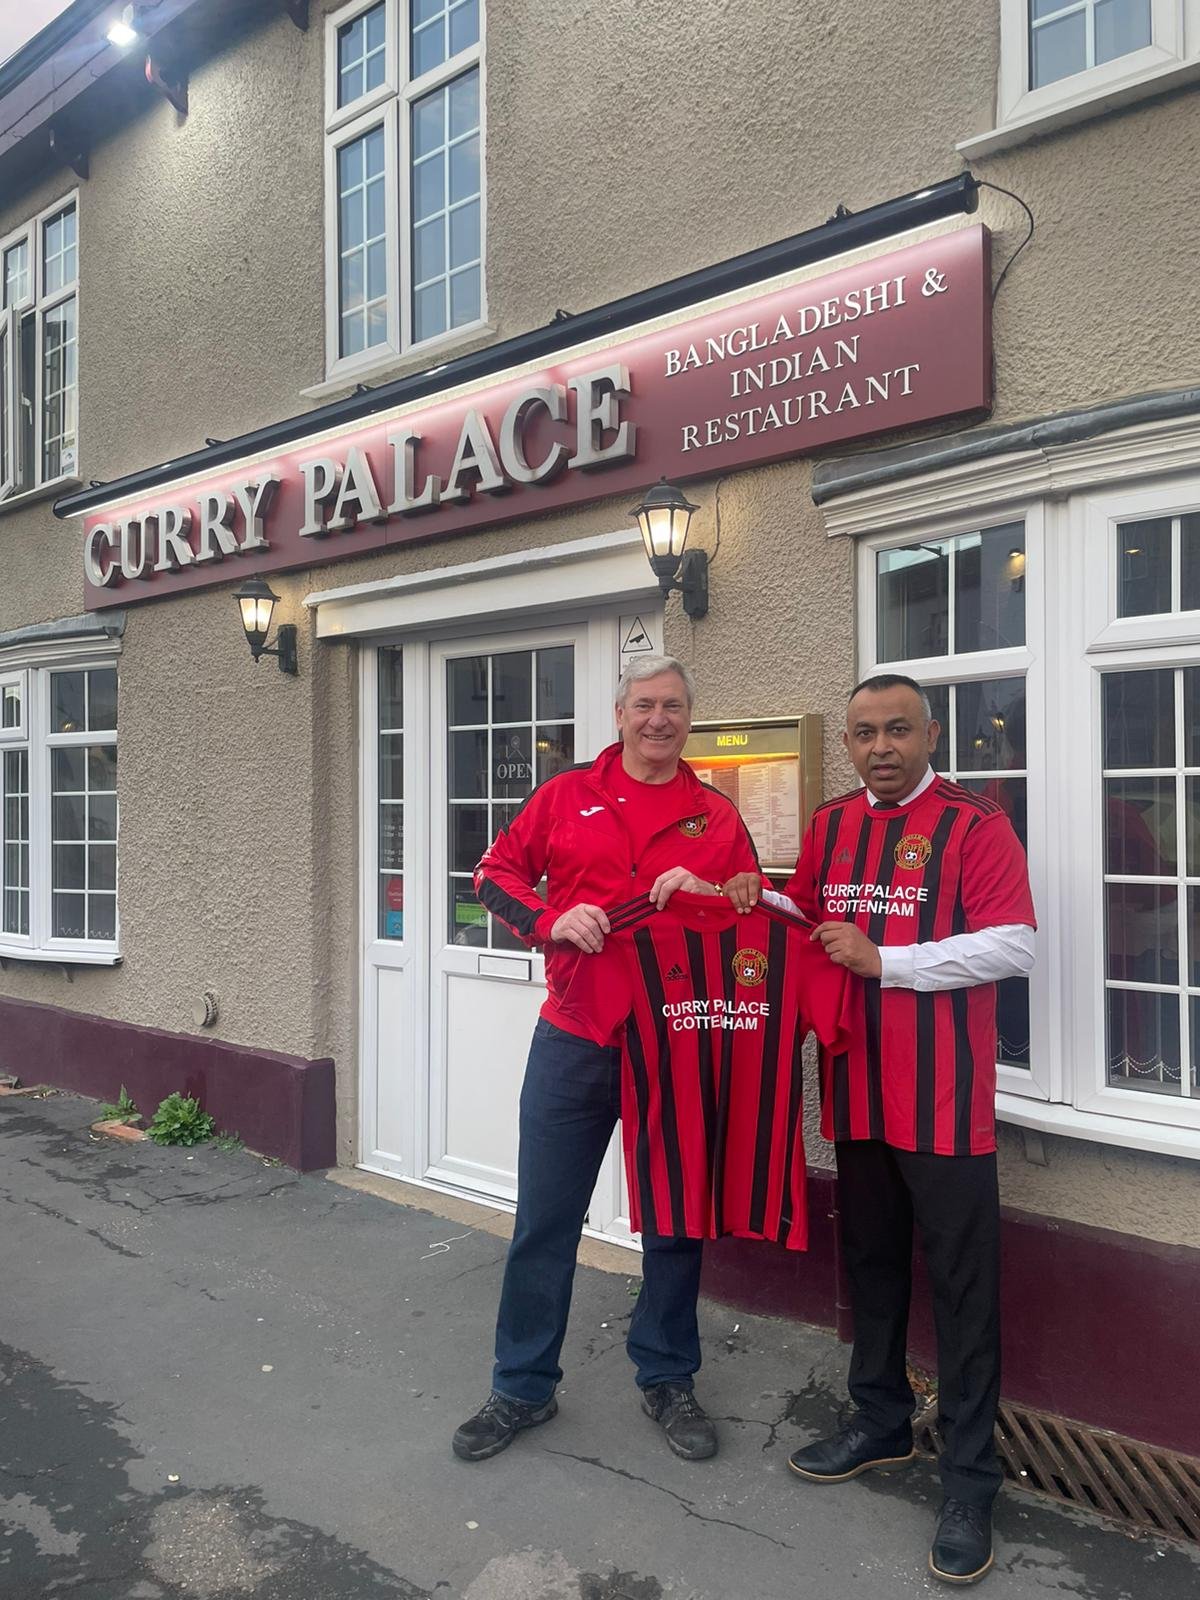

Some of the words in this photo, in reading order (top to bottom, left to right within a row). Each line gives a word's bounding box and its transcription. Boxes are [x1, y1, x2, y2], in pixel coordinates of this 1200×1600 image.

[664, 275, 907, 378] BANGLADESHI
[921, 267, 948, 298] &
[730, 335, 860, 398] INDIAN
[680, 364, 920, 452] RESTAURANT
[84, 473, 280, 588] CURRY
[299, 363, 636, 537] PALACE
[716, 734, 748, 747] MENU
[823, 885, 864, 897] CURRY
[864, 884, 929, 902] PALACE
[827, 900, 914, 916] COTTENHAM
[662, 1000, 710, 1017] CURRY
